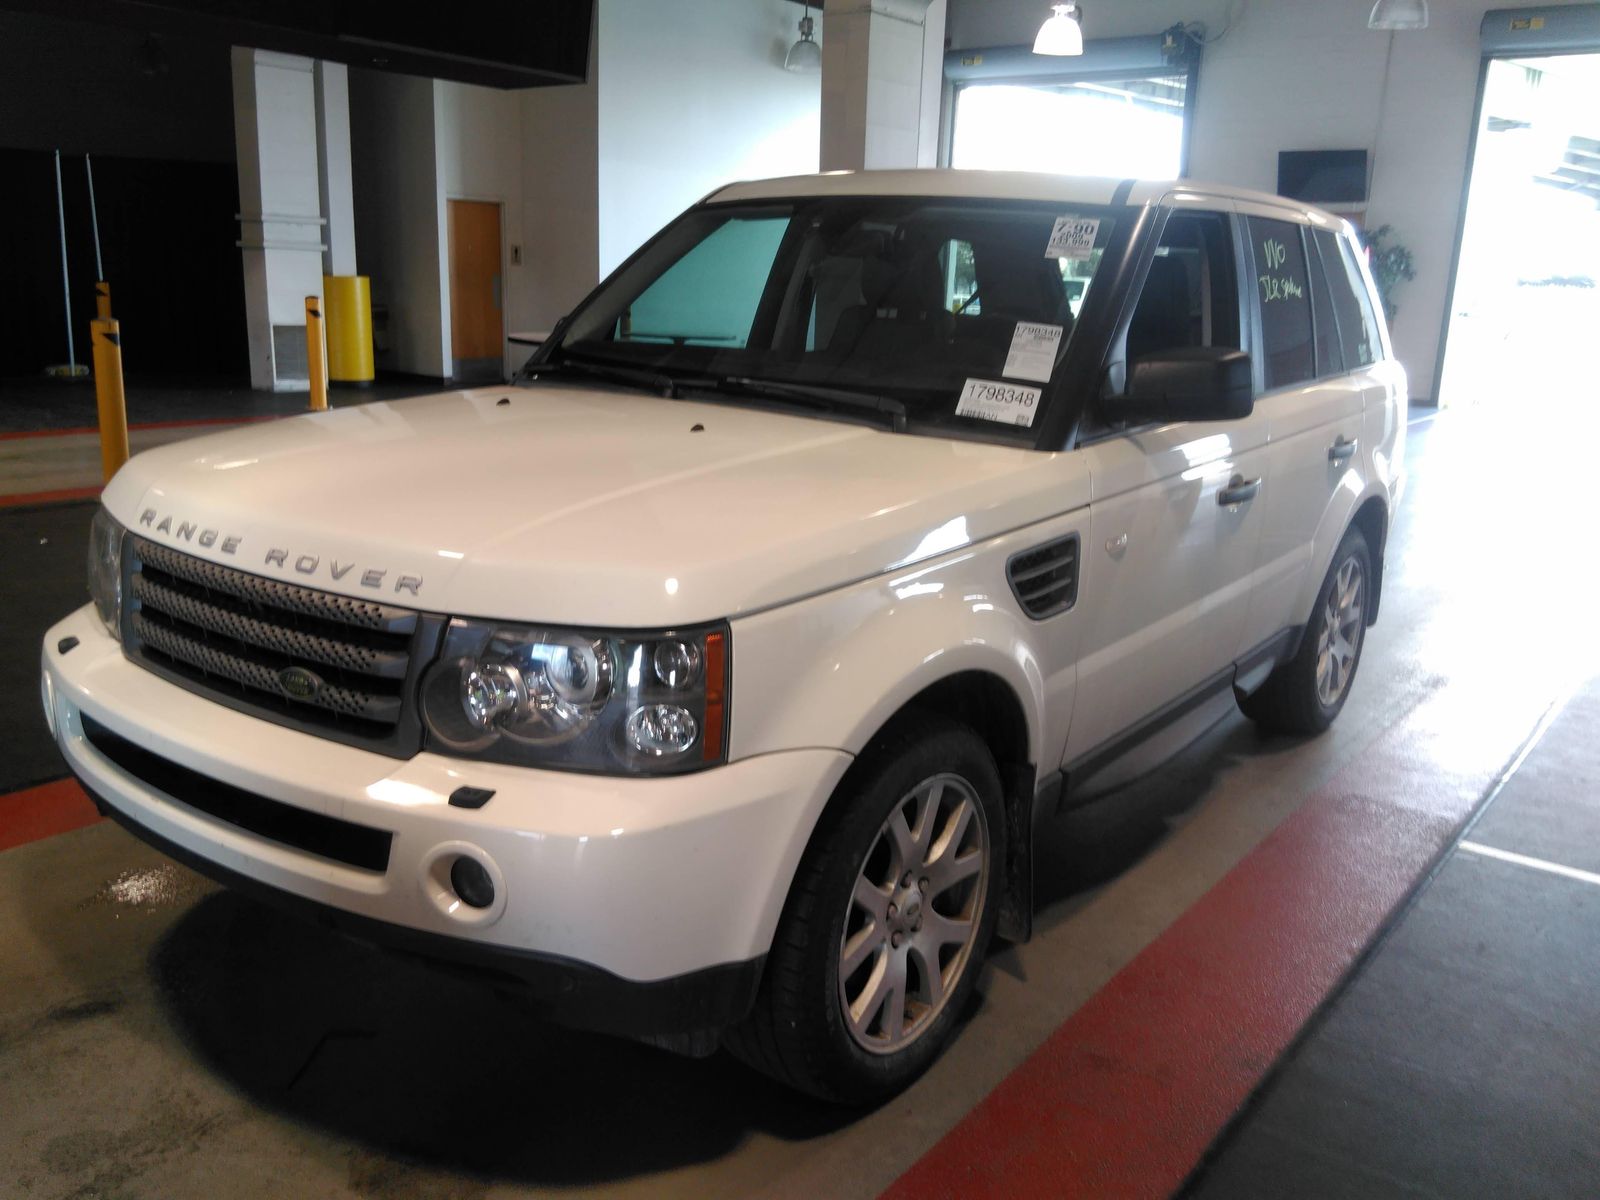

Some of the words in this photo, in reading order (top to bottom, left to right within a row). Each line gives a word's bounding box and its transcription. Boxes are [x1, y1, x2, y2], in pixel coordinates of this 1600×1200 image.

[1015, 325, 1061, 338] 1798348
[969, 384, 1035, 408] 1798348
[139, 508, 242, 554] RANGE
[264, 548, 423, 595] ROVER
